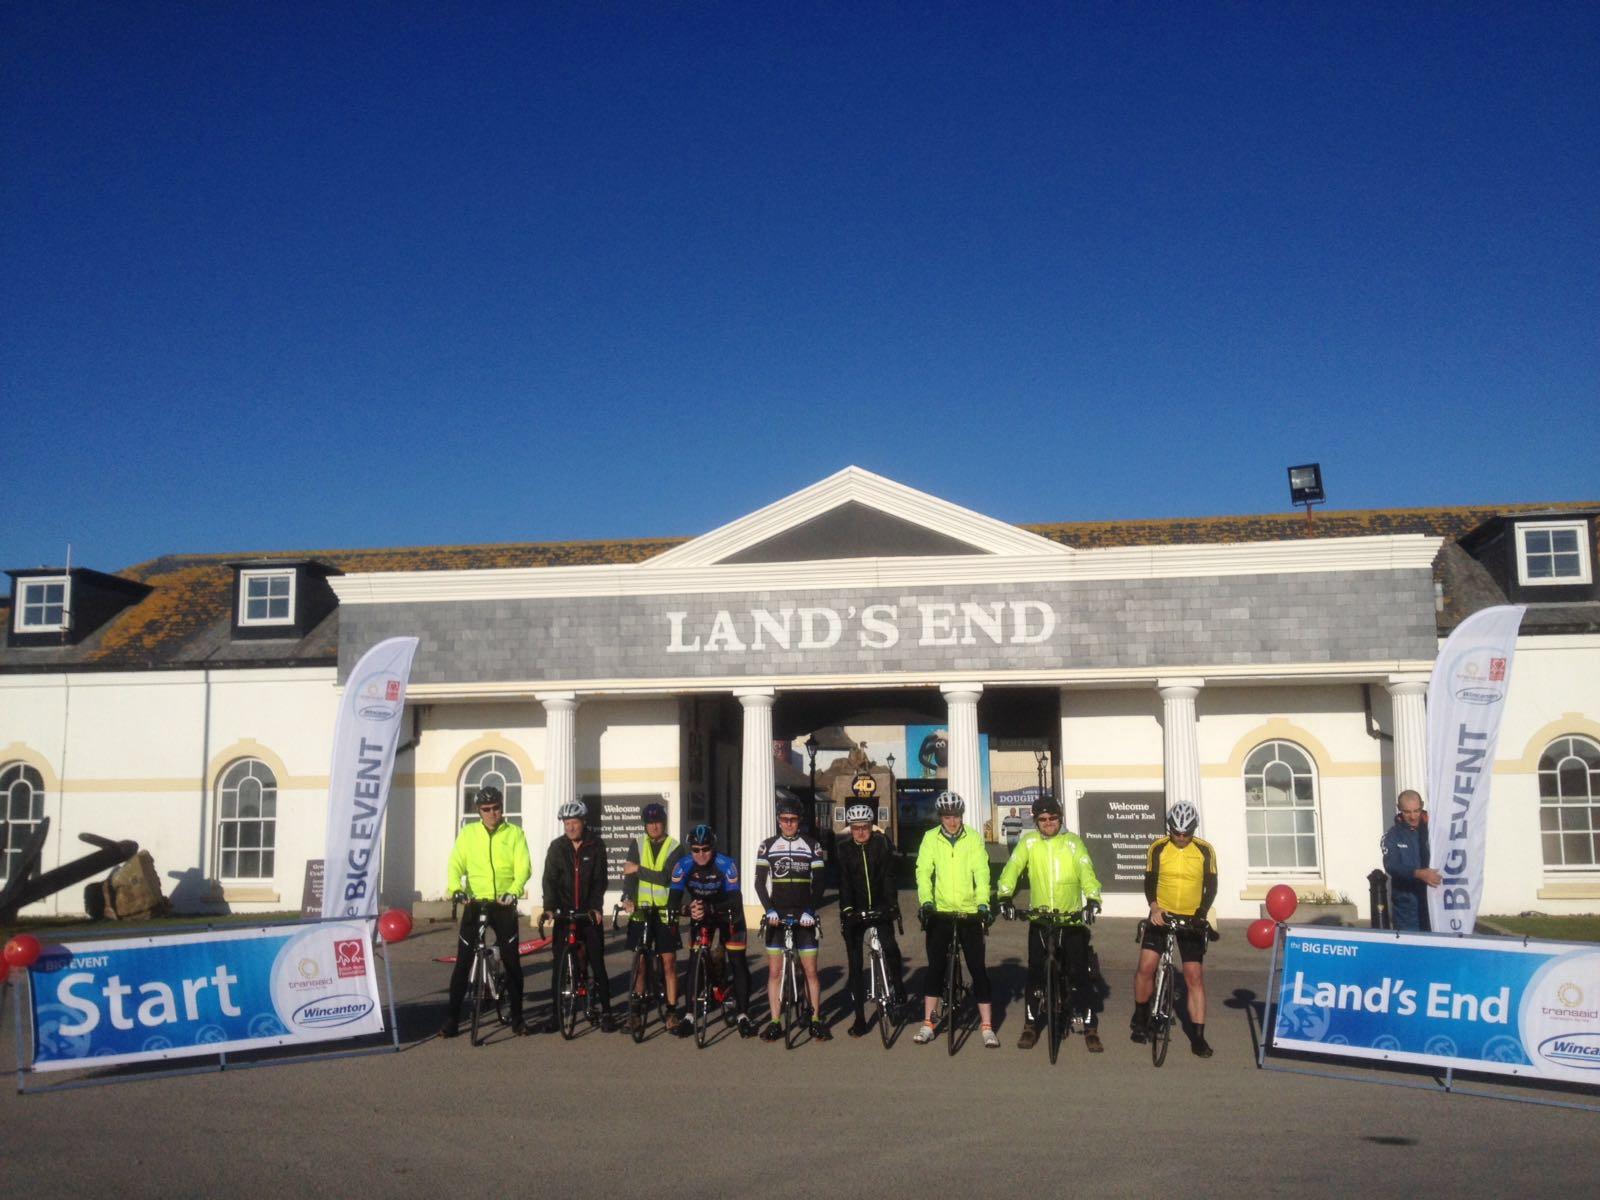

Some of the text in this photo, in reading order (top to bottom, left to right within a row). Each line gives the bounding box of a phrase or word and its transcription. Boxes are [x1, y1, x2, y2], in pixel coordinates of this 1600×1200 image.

[666, 600, 1056, 653] LAND'S END
[350, 737, 383, 840] EVENT
[853, 779, 876, 792] 4D
[1449, 723, 1487, 842] EVENT
[604, 804, 640, 813] Welcome
[1109, 802, 1150, 811] Welcome
[344, 848, 371, 901] BIG
[1442, 849, 1470, 910] BIG
[1302, 942, 1321, 954] BIG
[1322, 943, 1359, 957] EVENT
[69, 955, 109, 969] EVENT
[56, 963, 242, 1037] Start
[1292, 971, 1511, 1025] Land's End
[303, 1003, 367, 1018] Wincanton
[1541, 1006, 1599, 1019] transaid
[1553, 1040, 1600, 1056] Winca
